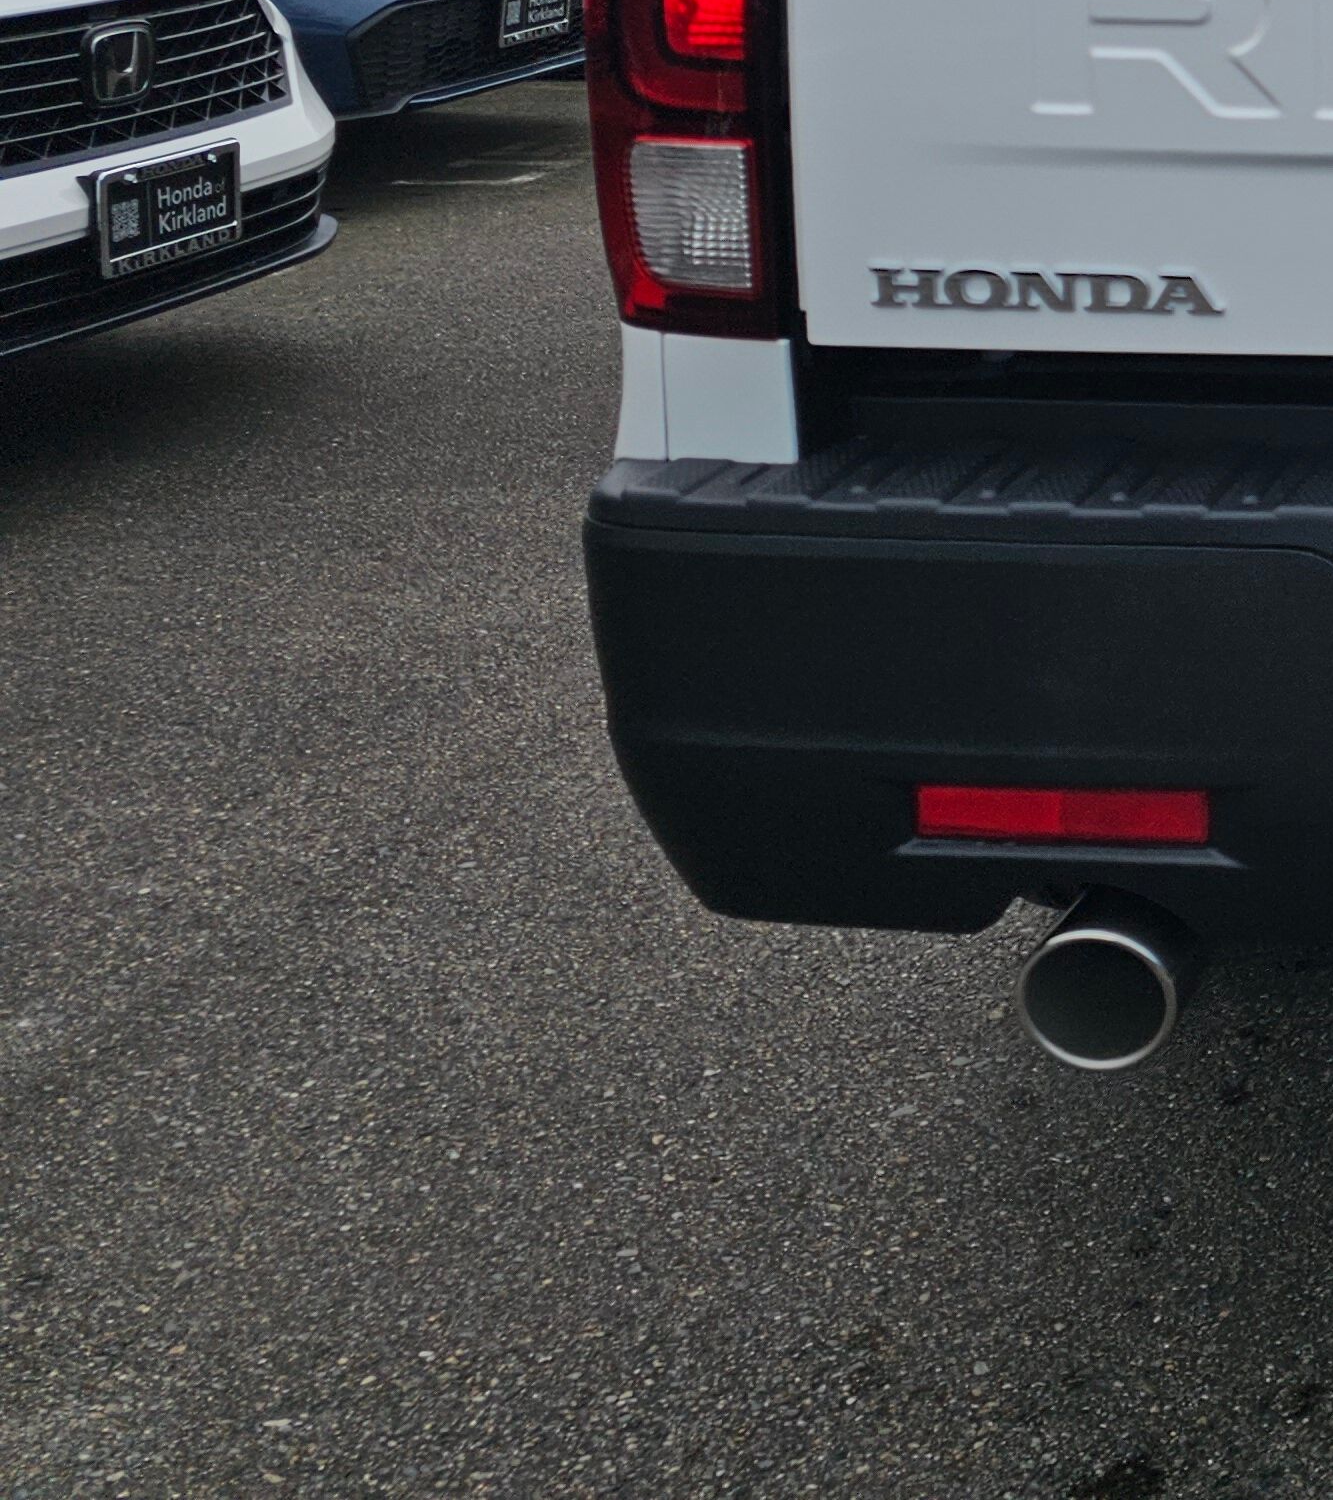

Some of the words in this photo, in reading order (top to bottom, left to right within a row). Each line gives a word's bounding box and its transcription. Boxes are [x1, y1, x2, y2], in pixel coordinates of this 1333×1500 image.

[157, 176, 213, 209] Honda
[214, 178, 226, 193] of
[158, 195, 227, 235] Kirkland
[869, 267, 1225, 316] HONDA
